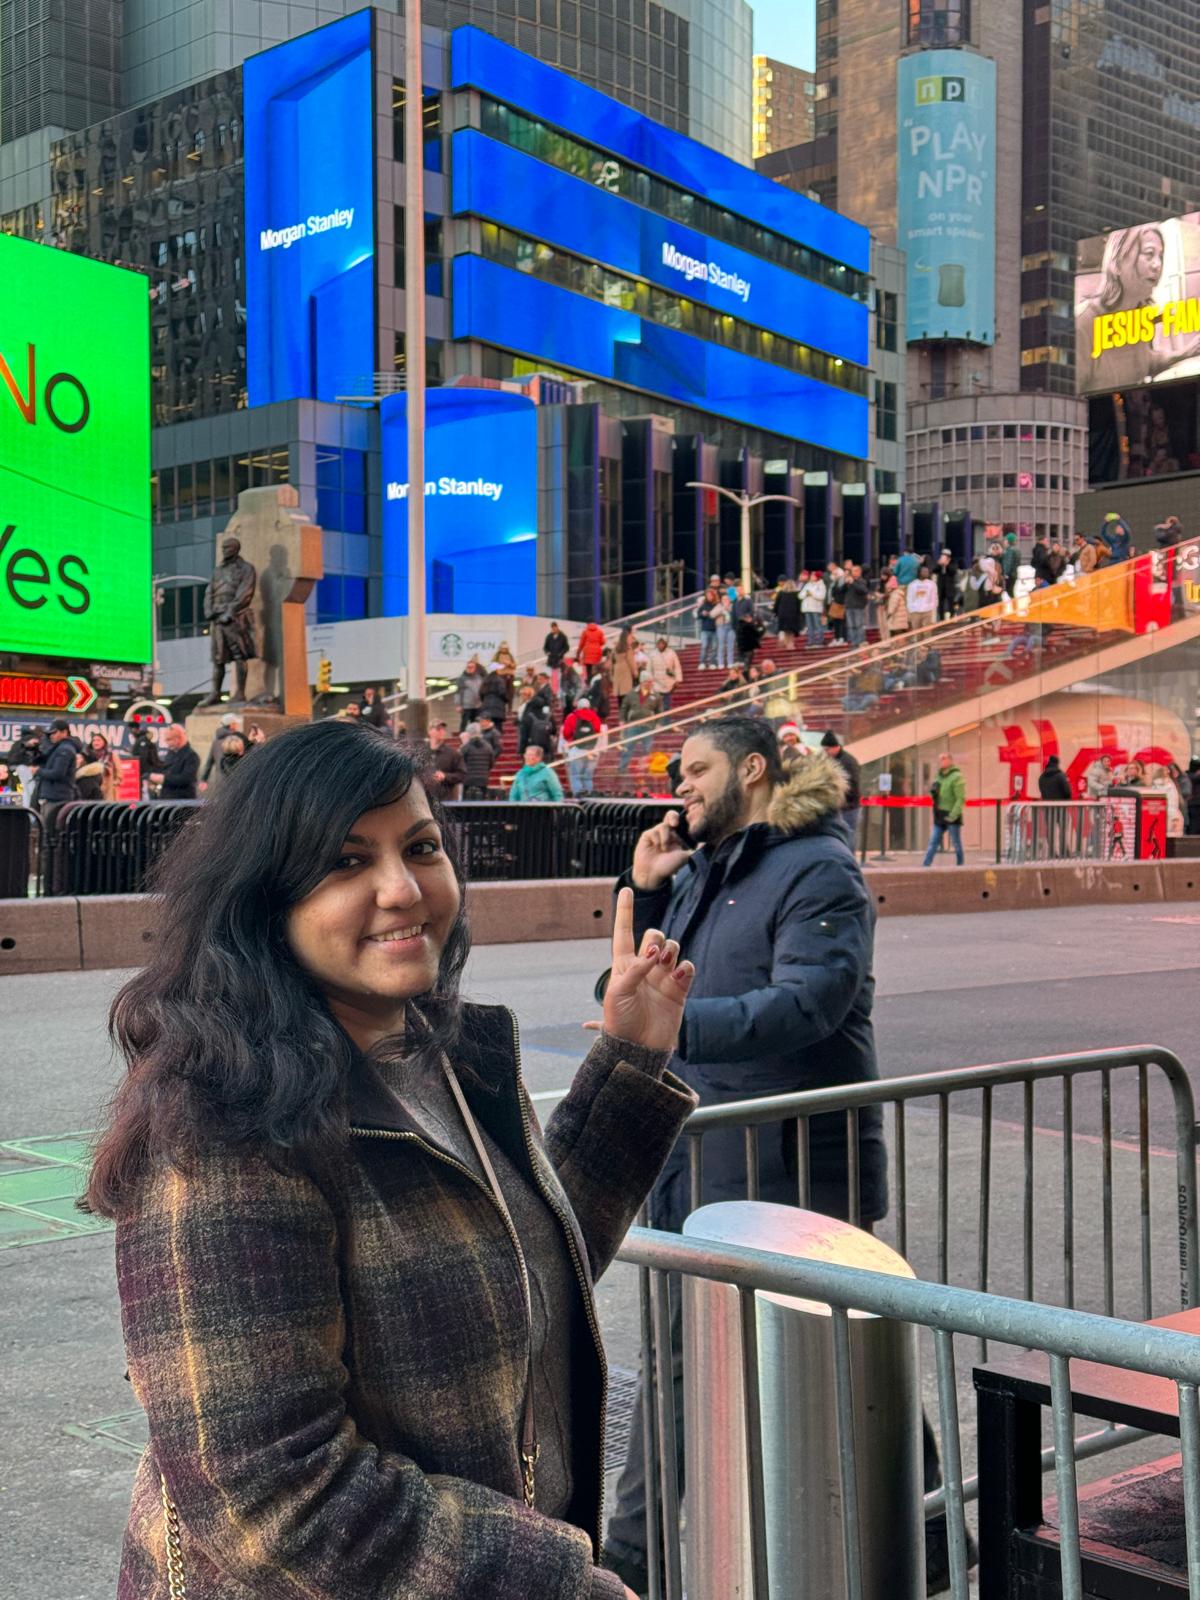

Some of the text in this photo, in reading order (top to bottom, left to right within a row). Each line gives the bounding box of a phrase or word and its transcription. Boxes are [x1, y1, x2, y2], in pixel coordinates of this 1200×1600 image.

[260, 208, 354, 251] Morgan Stanley
[662, 242, 751, 303] Morgan Stanley
[386, 476, 503, 501] Morn Stanley
[466, 641, 496, 650] OPEN
